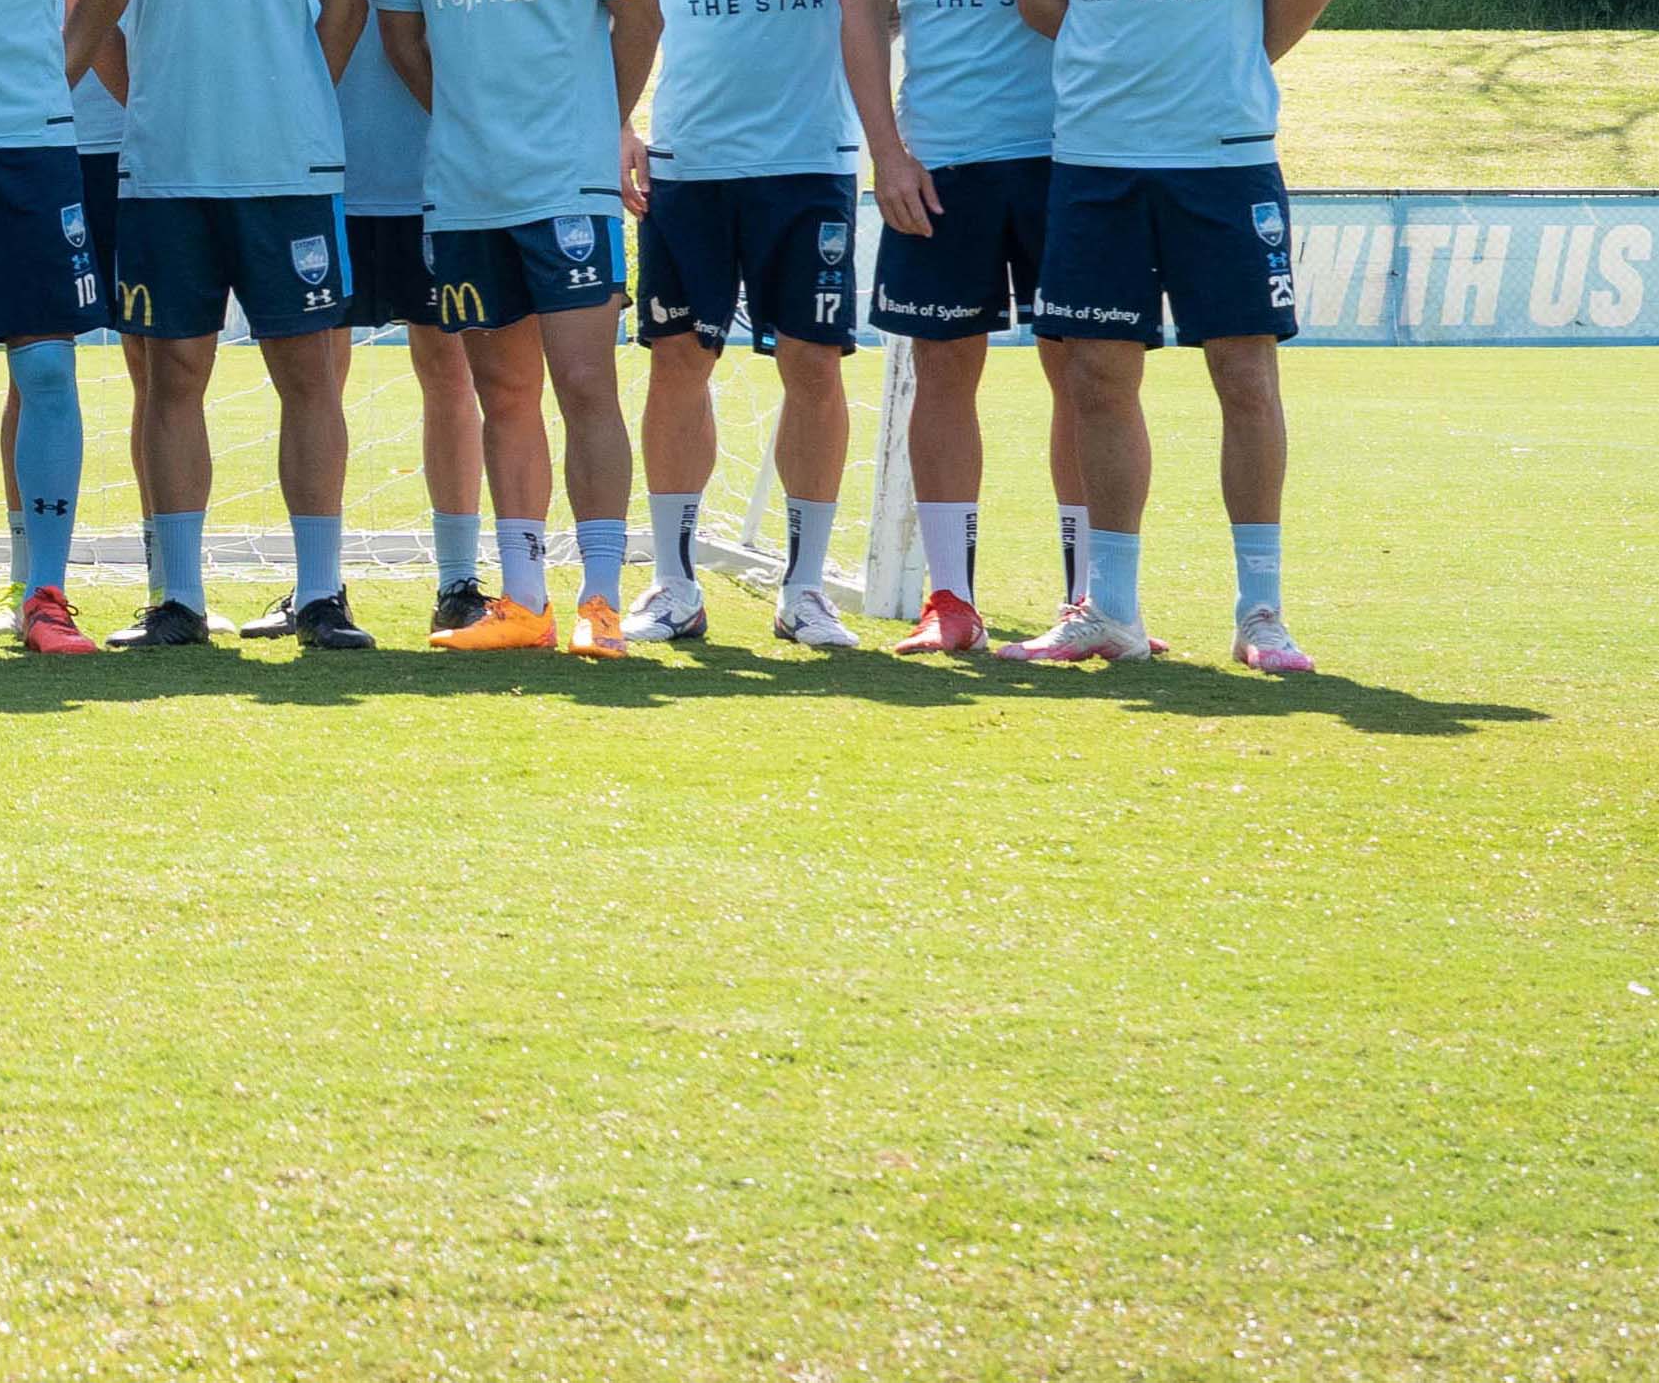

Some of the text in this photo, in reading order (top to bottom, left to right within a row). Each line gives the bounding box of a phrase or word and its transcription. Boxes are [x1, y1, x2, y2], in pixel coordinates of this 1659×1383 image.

[74, 273, 97, 309] 10
[1268, 274, 1295, 308] 25
[1287, 223, 1653, 328] WITH US
[669, 306, 720, 337] Ba dney
[813, 292, 842, 324] 17
[887, 298, 982, 322] Bank of Sydney
[1075, 307, 1090, 319] of
[1093, 308, 1141, 324] Sydney
